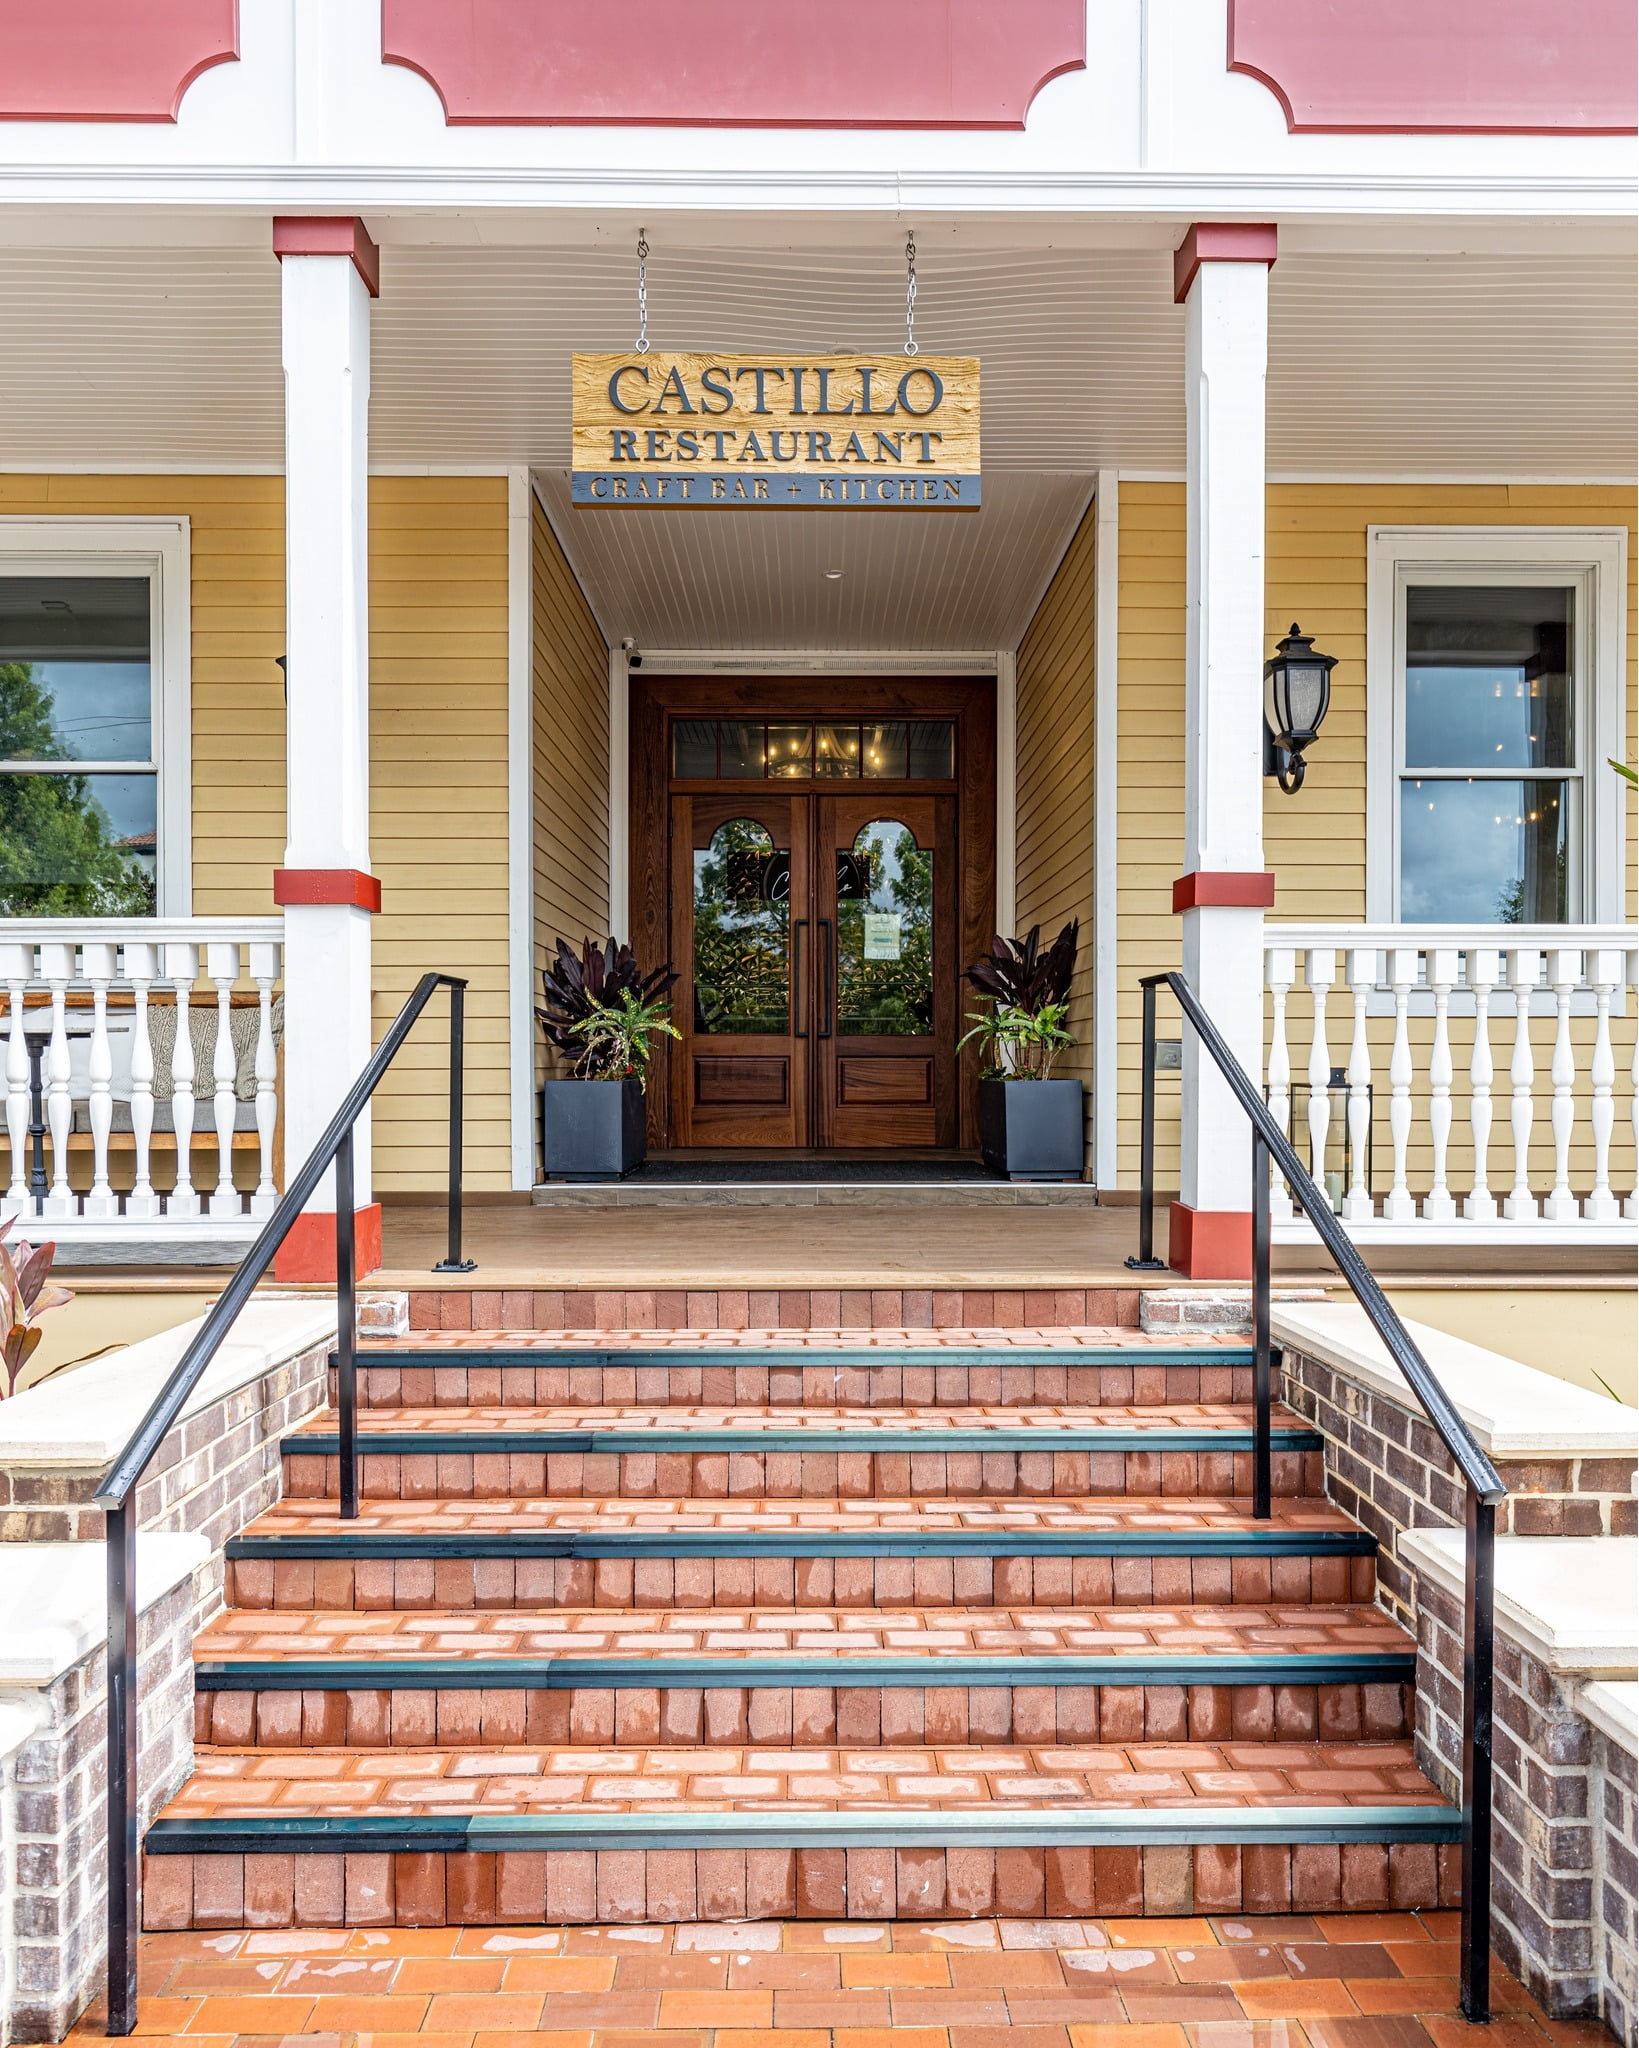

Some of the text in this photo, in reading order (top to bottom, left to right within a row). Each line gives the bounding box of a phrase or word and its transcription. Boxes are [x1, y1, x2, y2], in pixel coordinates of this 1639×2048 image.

[608, 365, 944, 415] CASTILLO
[609, 430, 943, 463] RESTAURANT
[590, 477, 696, 500] CRAFT
[711, 478, 770, 500] BAR
[818, 478, 962, 501] KITCHEN
